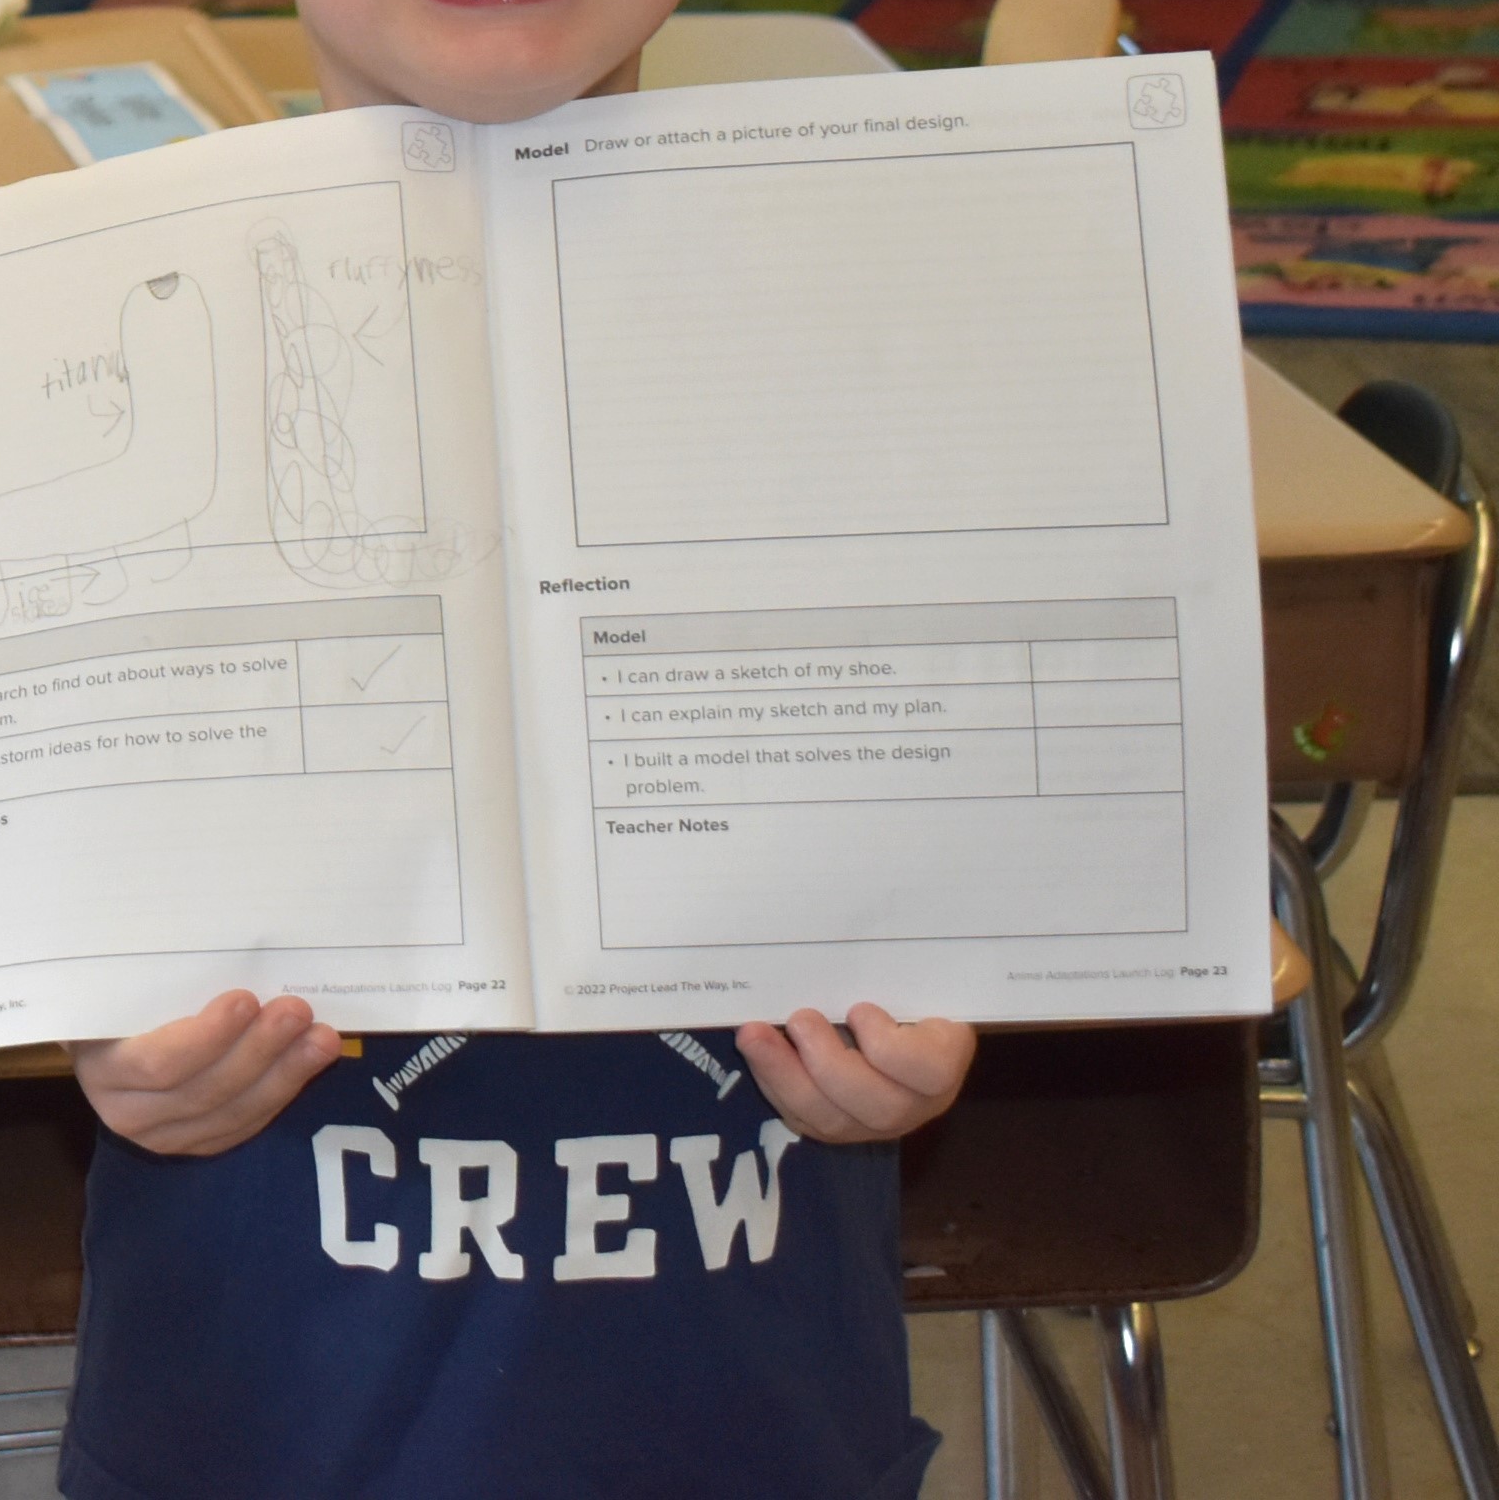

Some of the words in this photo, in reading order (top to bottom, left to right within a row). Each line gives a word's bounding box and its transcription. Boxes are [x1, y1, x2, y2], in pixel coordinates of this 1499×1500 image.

[515, 142, 570, 161] Model
[585, 134, 628, 153] Draw
[634, 135, 650, 148] or
[657, 128, 710, 146] attach
[716, 129, 726, 142] a
[732, 123, 792, 144] picture
[798, 121, 815, 138] of
[820, 120, 858, 140] your
[864, 117, 900, 134] final
[905, 114, 969, 133] design.
[539, 576, 630, 595] Reflection
[593, 629, 646, 644] Model
[33, 681, 48, 696] to
[52, 675, 81, 692] find
[86, 671, 113, 687] out
[117, 664, 166, 683] about
[170, 662, 215, 680] ways
[220, 659, 237, 674] to
[242, 656, 288, 673] solve
[628, 670, 659, 684] can
[665, 666, 709, 682] draw
[714, 669, 725, 681] a
[731, 663, 788, 681] sketch
[794, 661, 811, 678] of
[817, 663, 844, 680] my
[849, 660, 896, 677] shoe.
[631, 709, 663, 723] can
[669, 704, 733, 725] explain
[738, 705, 764, 721] my
[770, 701, 827, 718] sketch
[834, 700, 866, 716] and
[873, 702, 899, 718] my
[904, 698, 947, 717] plan.
[48, 738, 92, 757] ideas
[97, 734, 119, 750] for
[124, 731, 161, 748] how
[165, 729, 183, 743] to
[188, 724, 234, 742] solve
[239, 723, 268, 739] the
[634, 751, 673, 767] built
[678, 754, 689, 767] a
[694, 749, 750, 766] model
[756, 748, 791, 765] that
[796, 746, 852, 763] solves
[857, 744, 886, 761] the
[891, 744, 951, 763] design
[626, 778, 704, 798] problem.
[606, 819, 673, 835] Teacher
[679, 817, 730, 833] Notes
[1180, 965, 1208, 977] Page
[1212, 965, 1228, 976] 23
[312, 1118, 800, 1282] CREW
